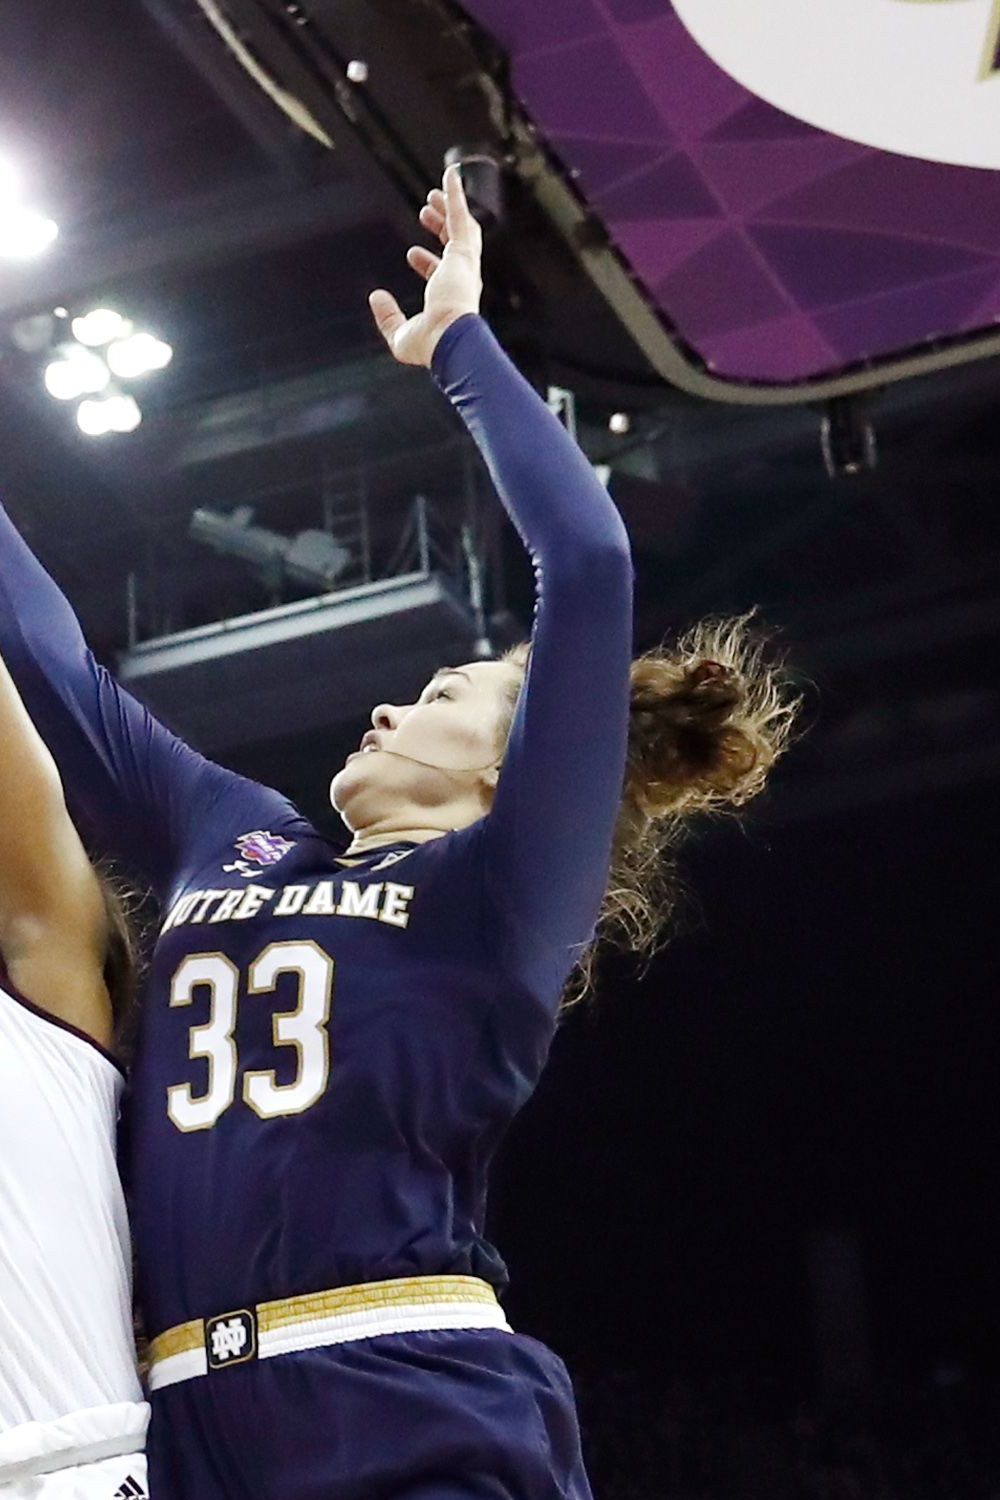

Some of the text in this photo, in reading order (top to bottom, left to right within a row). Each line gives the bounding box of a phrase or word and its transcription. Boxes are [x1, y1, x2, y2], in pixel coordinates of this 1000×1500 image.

[160, 880, 415, 936] NOTRE DAME
[167, 939, 335, 1133] 33
